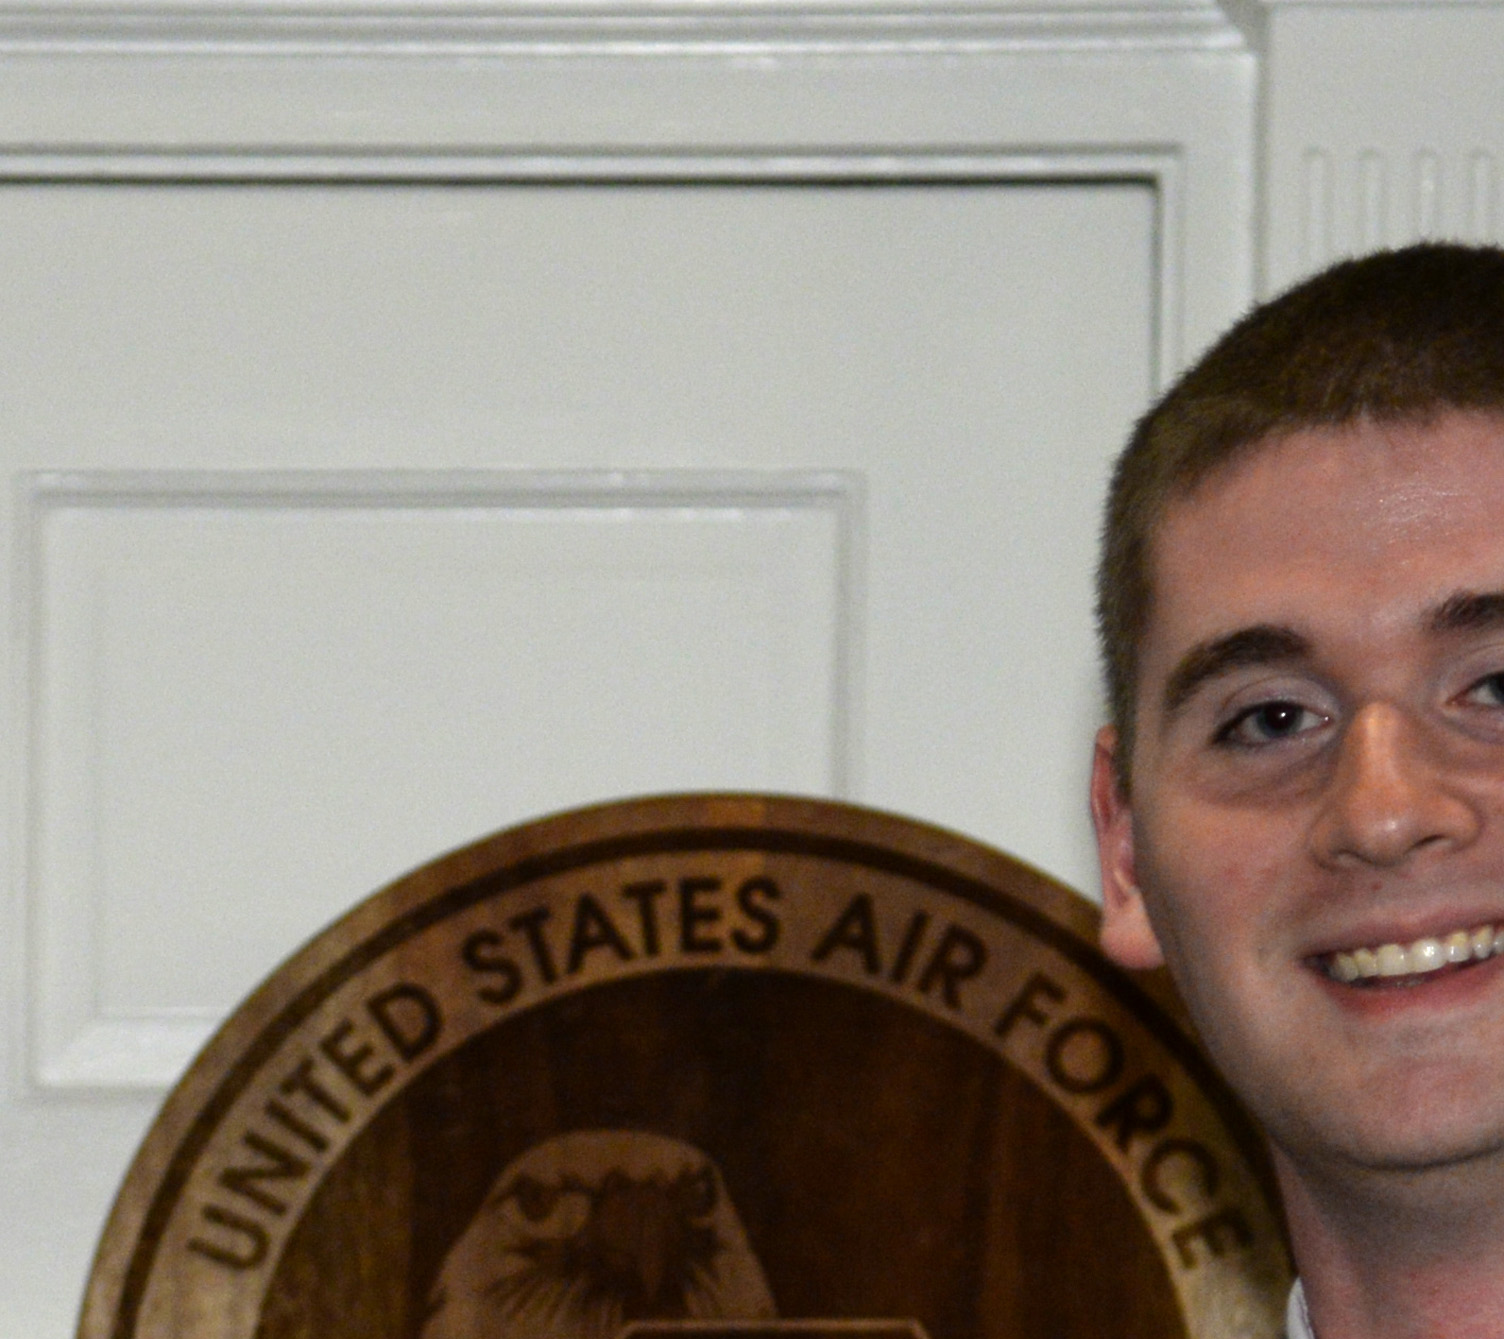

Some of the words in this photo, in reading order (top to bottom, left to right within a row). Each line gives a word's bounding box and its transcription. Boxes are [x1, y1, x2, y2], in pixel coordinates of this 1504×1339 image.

[186, 982, 443, 1272] UNITED
[462, 876, 781, 1006] STATES
[812, 892, 987, 1011] AIR
[994, 972, 1255, 1270] FORCE
